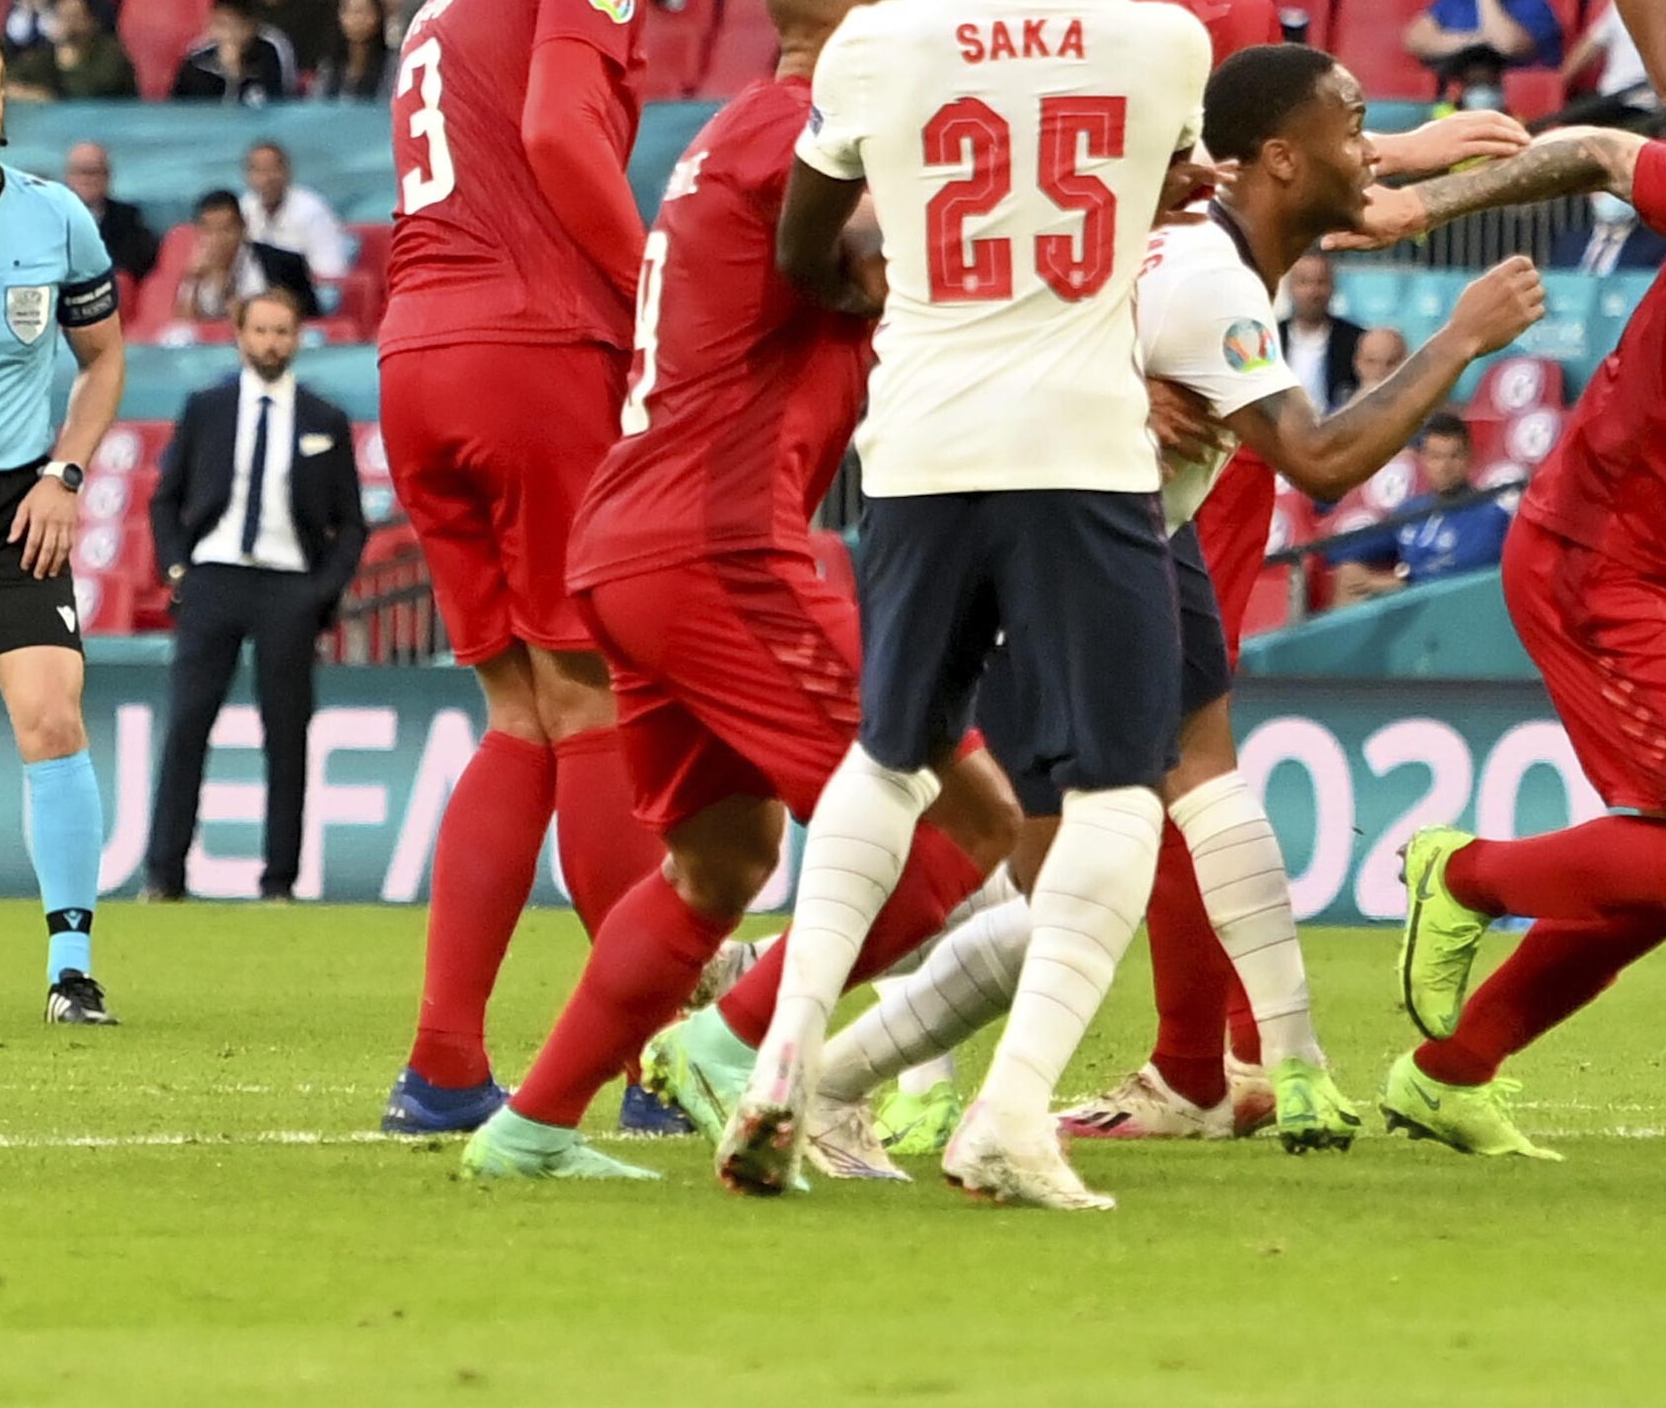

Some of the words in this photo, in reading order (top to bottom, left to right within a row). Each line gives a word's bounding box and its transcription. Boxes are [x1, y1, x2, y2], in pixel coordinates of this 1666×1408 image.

[397, 37, 455, 216] 3
[956, 19, 1085, 64] SAKA
[922, 96, 1127, 303] 25
[1235, 716, 1611, 922] 020
